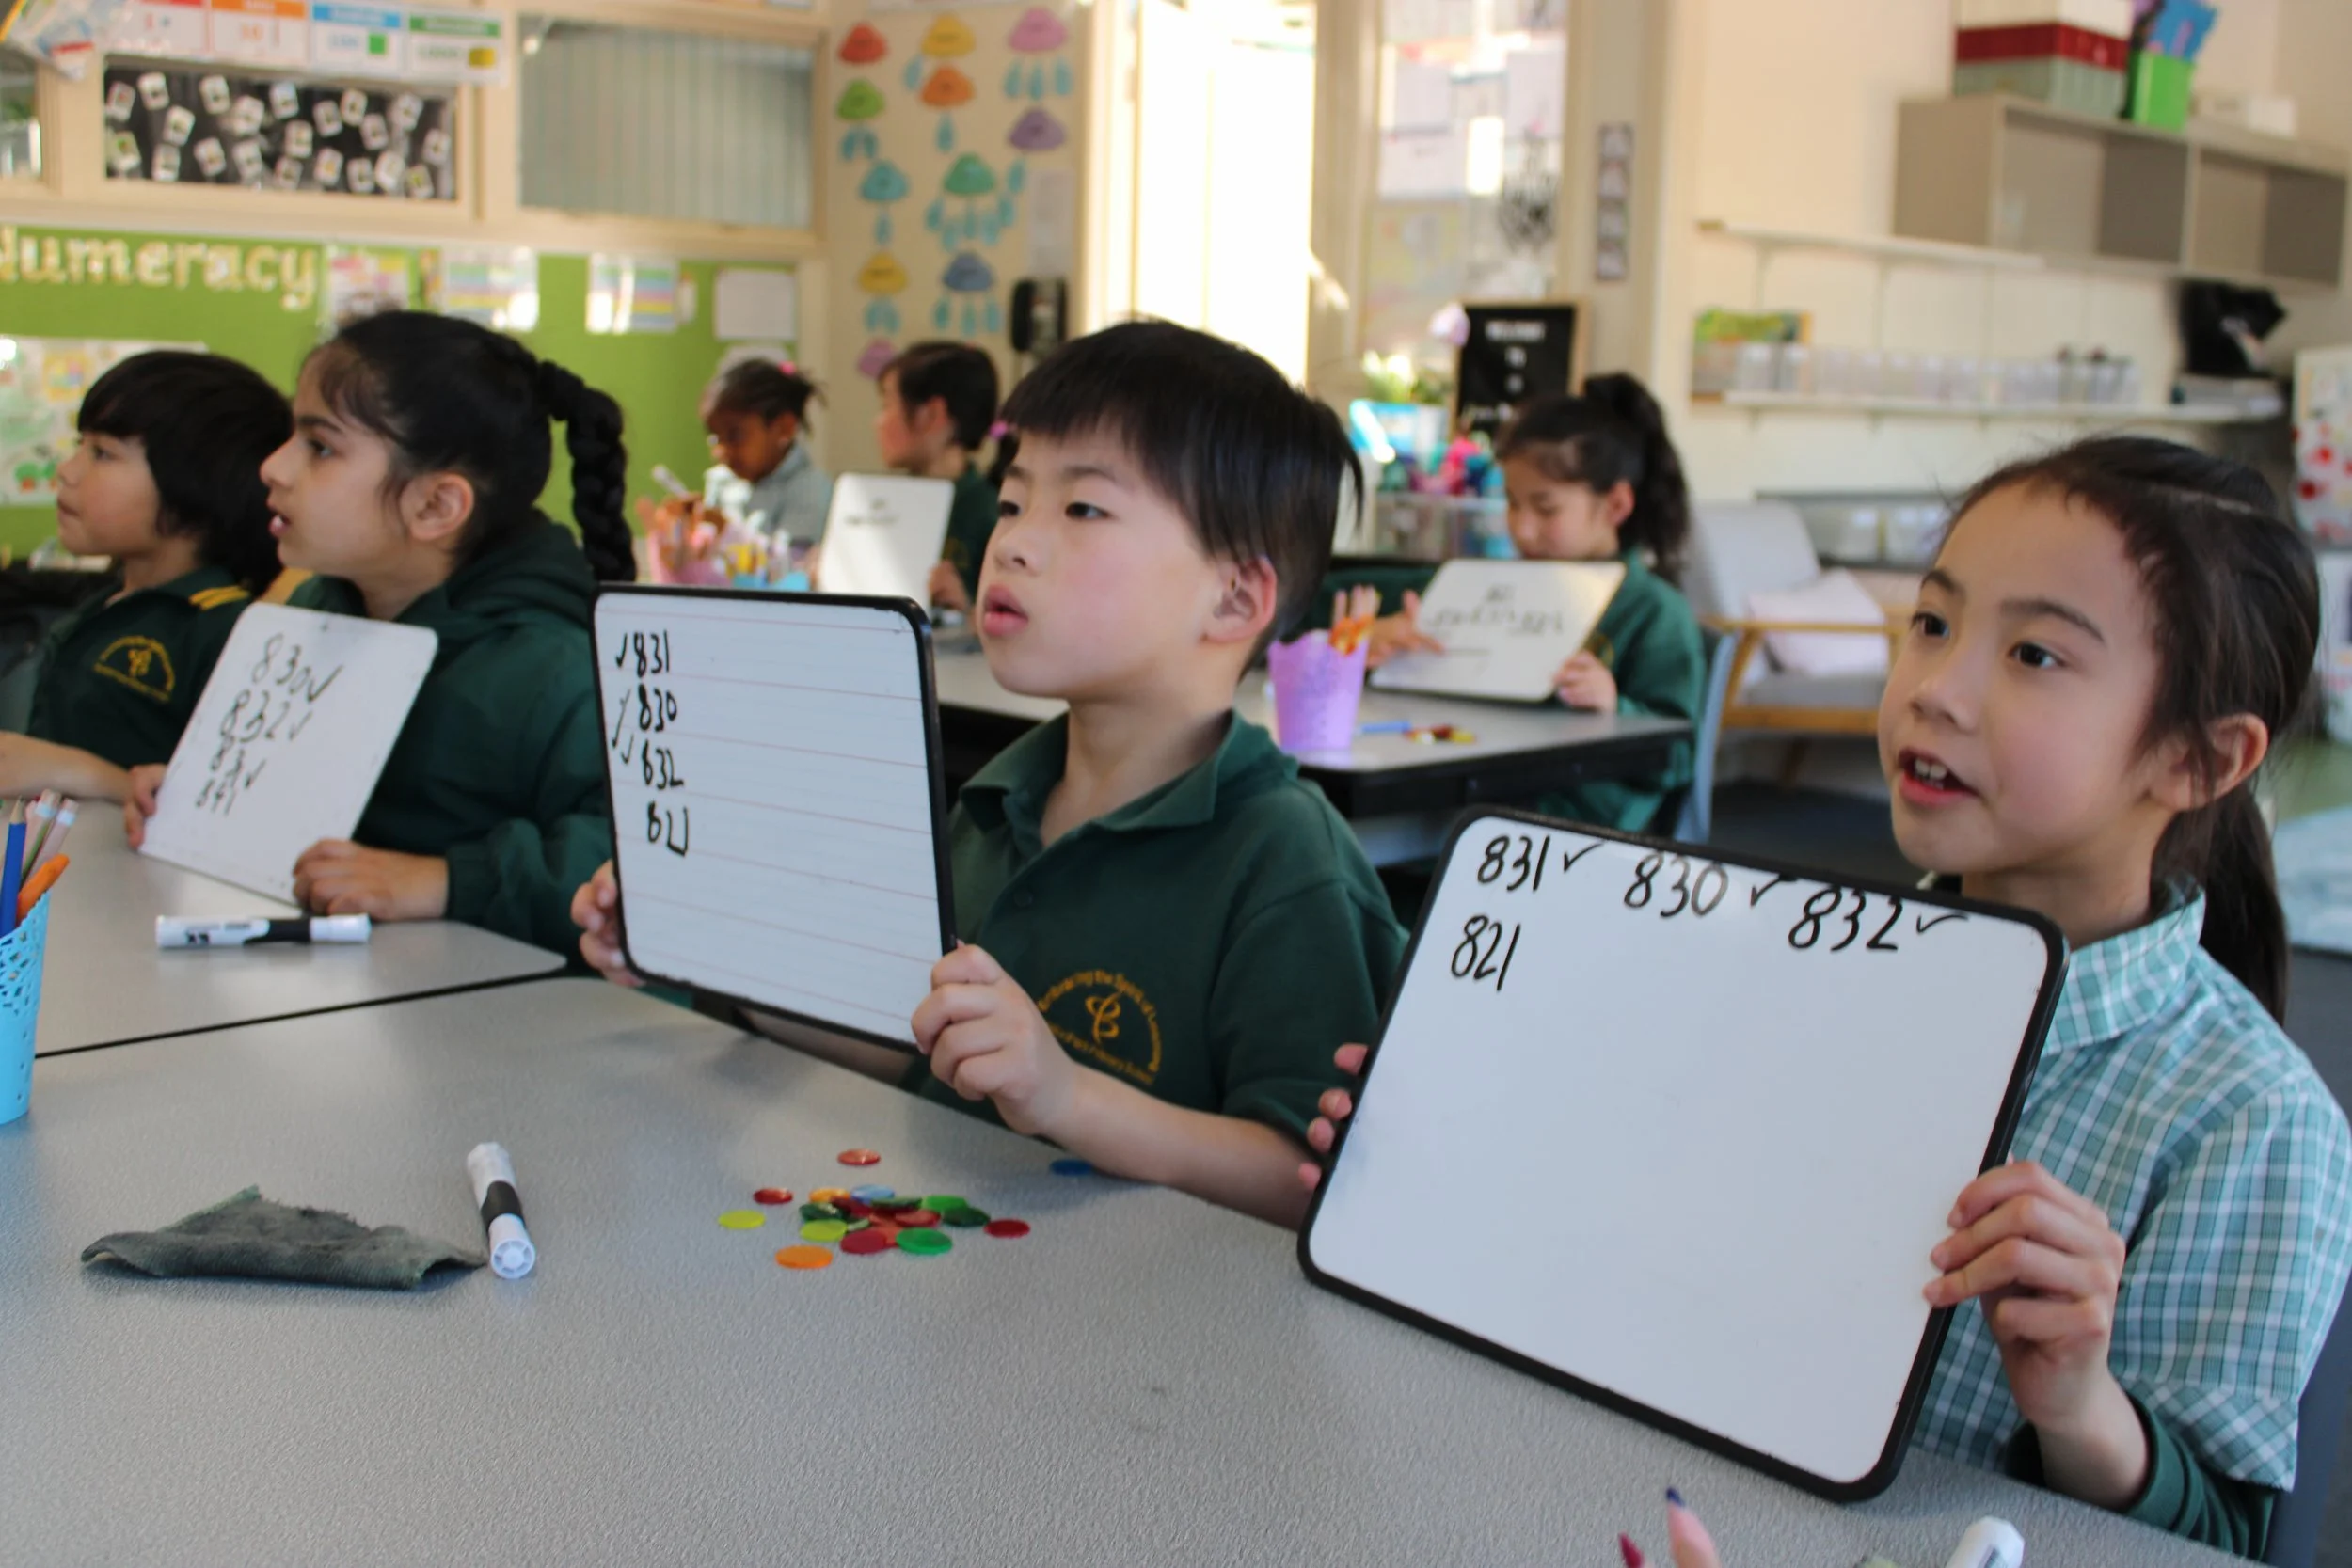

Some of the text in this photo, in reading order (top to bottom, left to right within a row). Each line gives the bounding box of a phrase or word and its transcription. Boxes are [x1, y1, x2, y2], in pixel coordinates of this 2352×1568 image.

[251, 632, 311, 695] 830
[633, 629, 670, 679] 831
[220, 689, 290, 743] 832
[638, 682, 677, 732] 830
[1477, 834, 1903, 952] 831 830 832
[1450, 914, 1520, 991] 821
